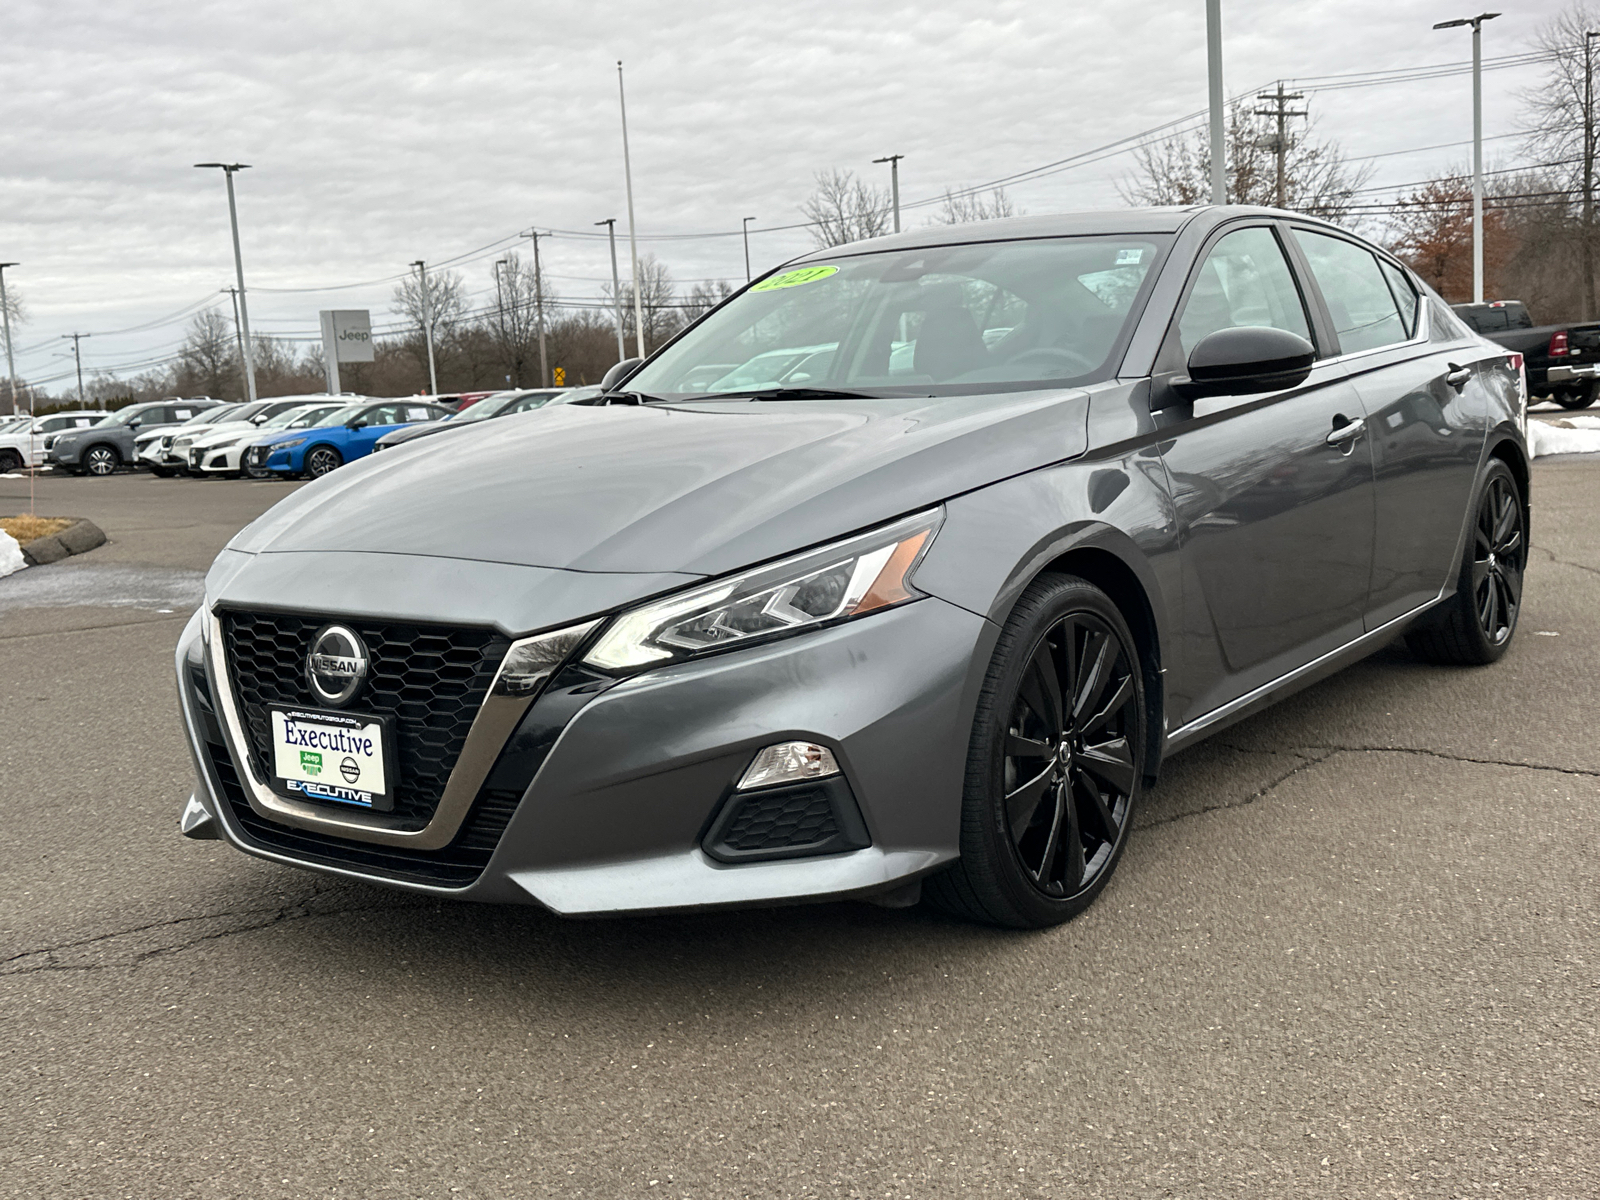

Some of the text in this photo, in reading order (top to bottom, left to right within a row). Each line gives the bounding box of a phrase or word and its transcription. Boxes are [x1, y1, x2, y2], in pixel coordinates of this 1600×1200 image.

[758, 269, 830, 290] 2021
[339, 330, 369, 342] Jeep
[312, 659, 357, 673] NISSAN
[283, 719, 373, 757] Executive
[303, 752, 320, 764] Jeep
[286, 779, 372, 804] EXECUTIVE
